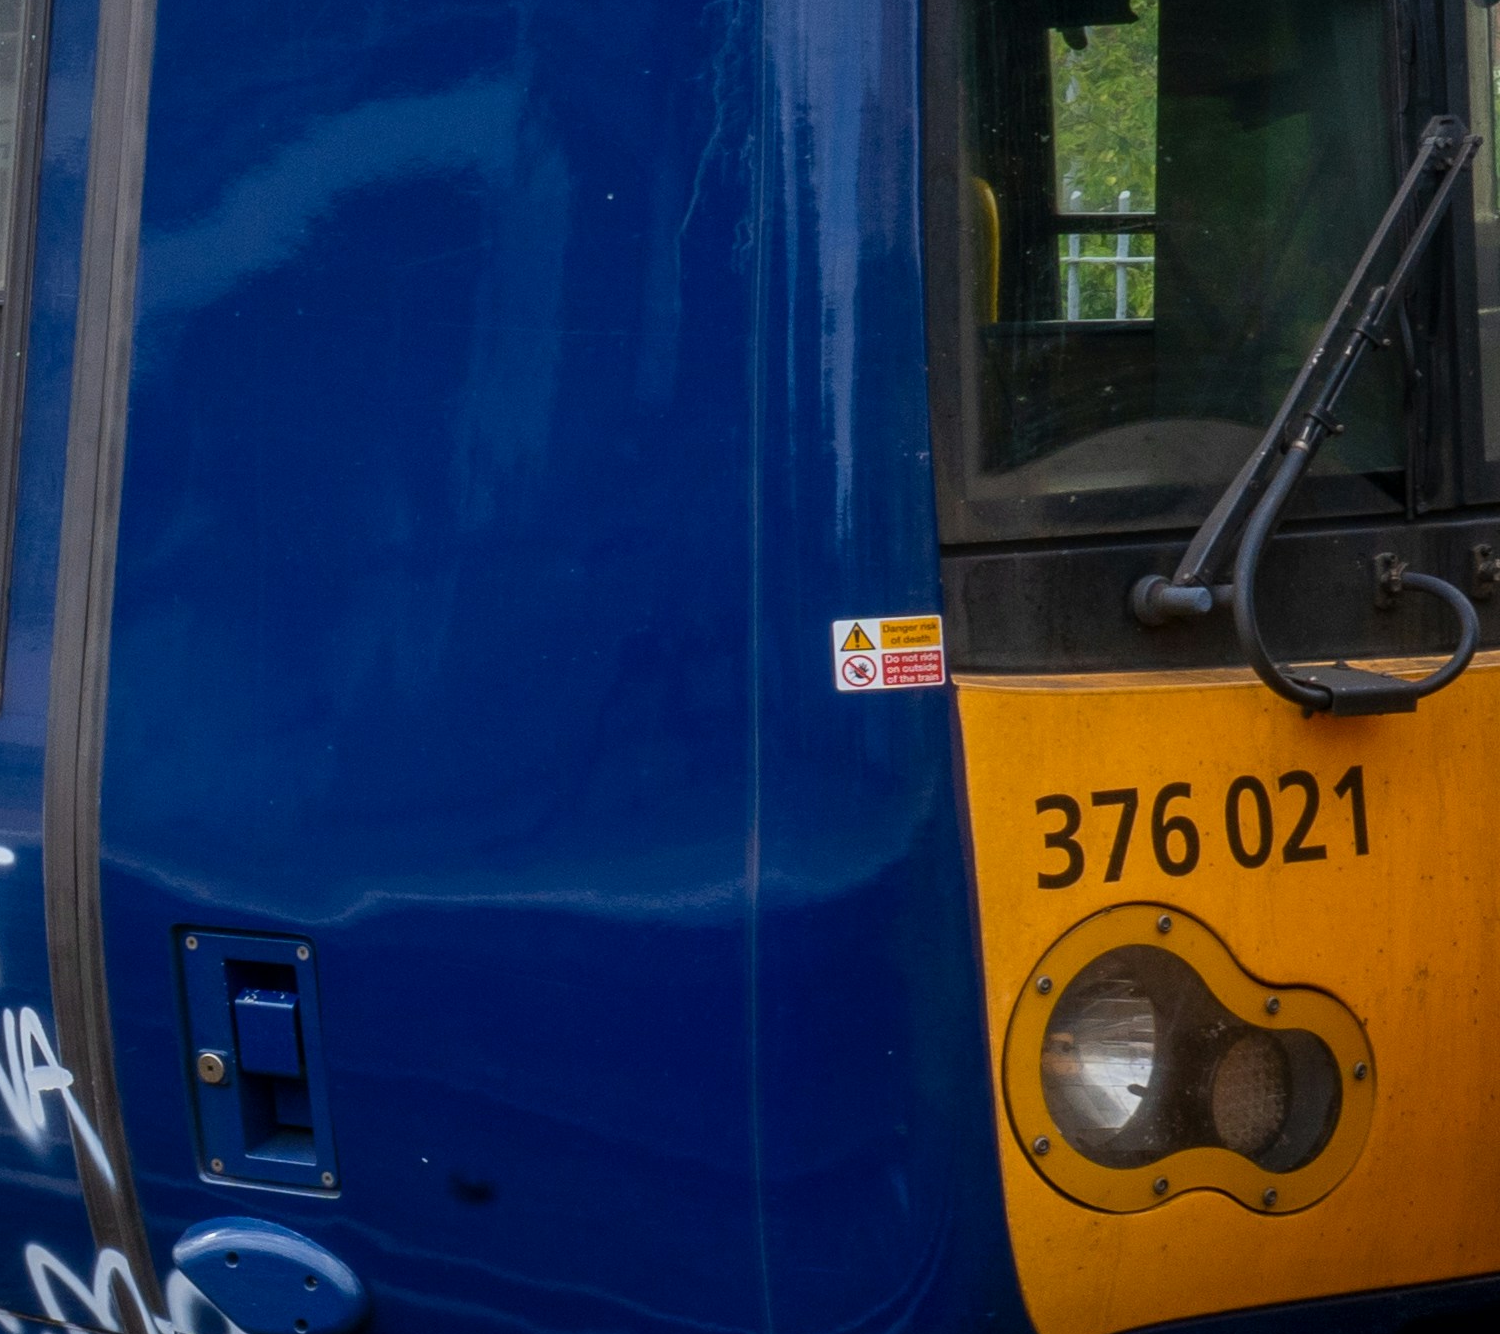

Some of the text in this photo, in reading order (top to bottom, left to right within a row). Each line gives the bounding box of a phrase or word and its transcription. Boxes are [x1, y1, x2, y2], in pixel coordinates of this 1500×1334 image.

[882, 622, 937, 633] Danger risk
[891, 634, 931, 644] of death
[885, 652, 938, 663] Do not ride
[902, 664, 938, 673] outside
[886, 673, 939, 684] of the train
[1036, 765, 1373, 890] 376 021
